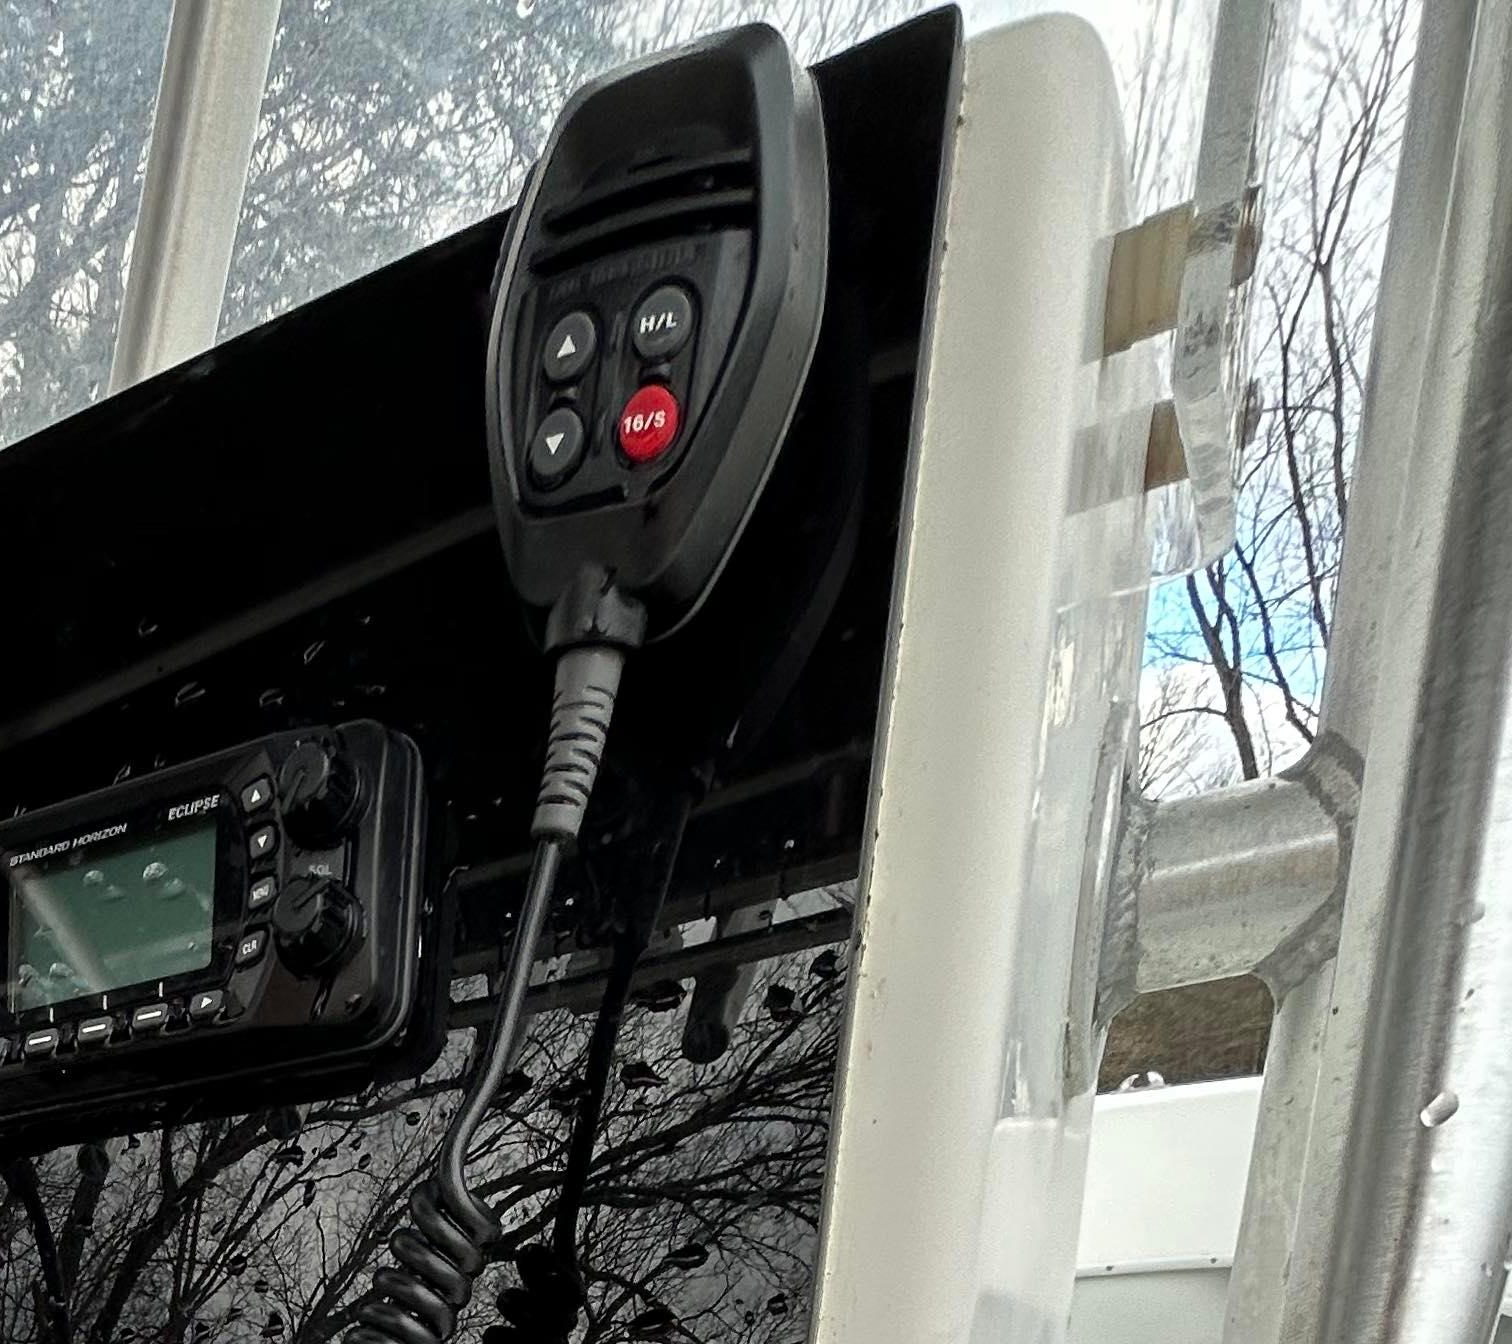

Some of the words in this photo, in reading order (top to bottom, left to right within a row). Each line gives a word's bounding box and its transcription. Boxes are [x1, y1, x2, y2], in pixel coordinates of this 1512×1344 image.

[639, 311, 677, 334] H/L
[623, 409, 666, 435] 16/S
[167, 794, 220, 821] ECLIPSE
[9, 840, 71, 867] STANDARD
[72, 822, 128, 849] HORIZON
[242, 939, 258, 955] CLR
